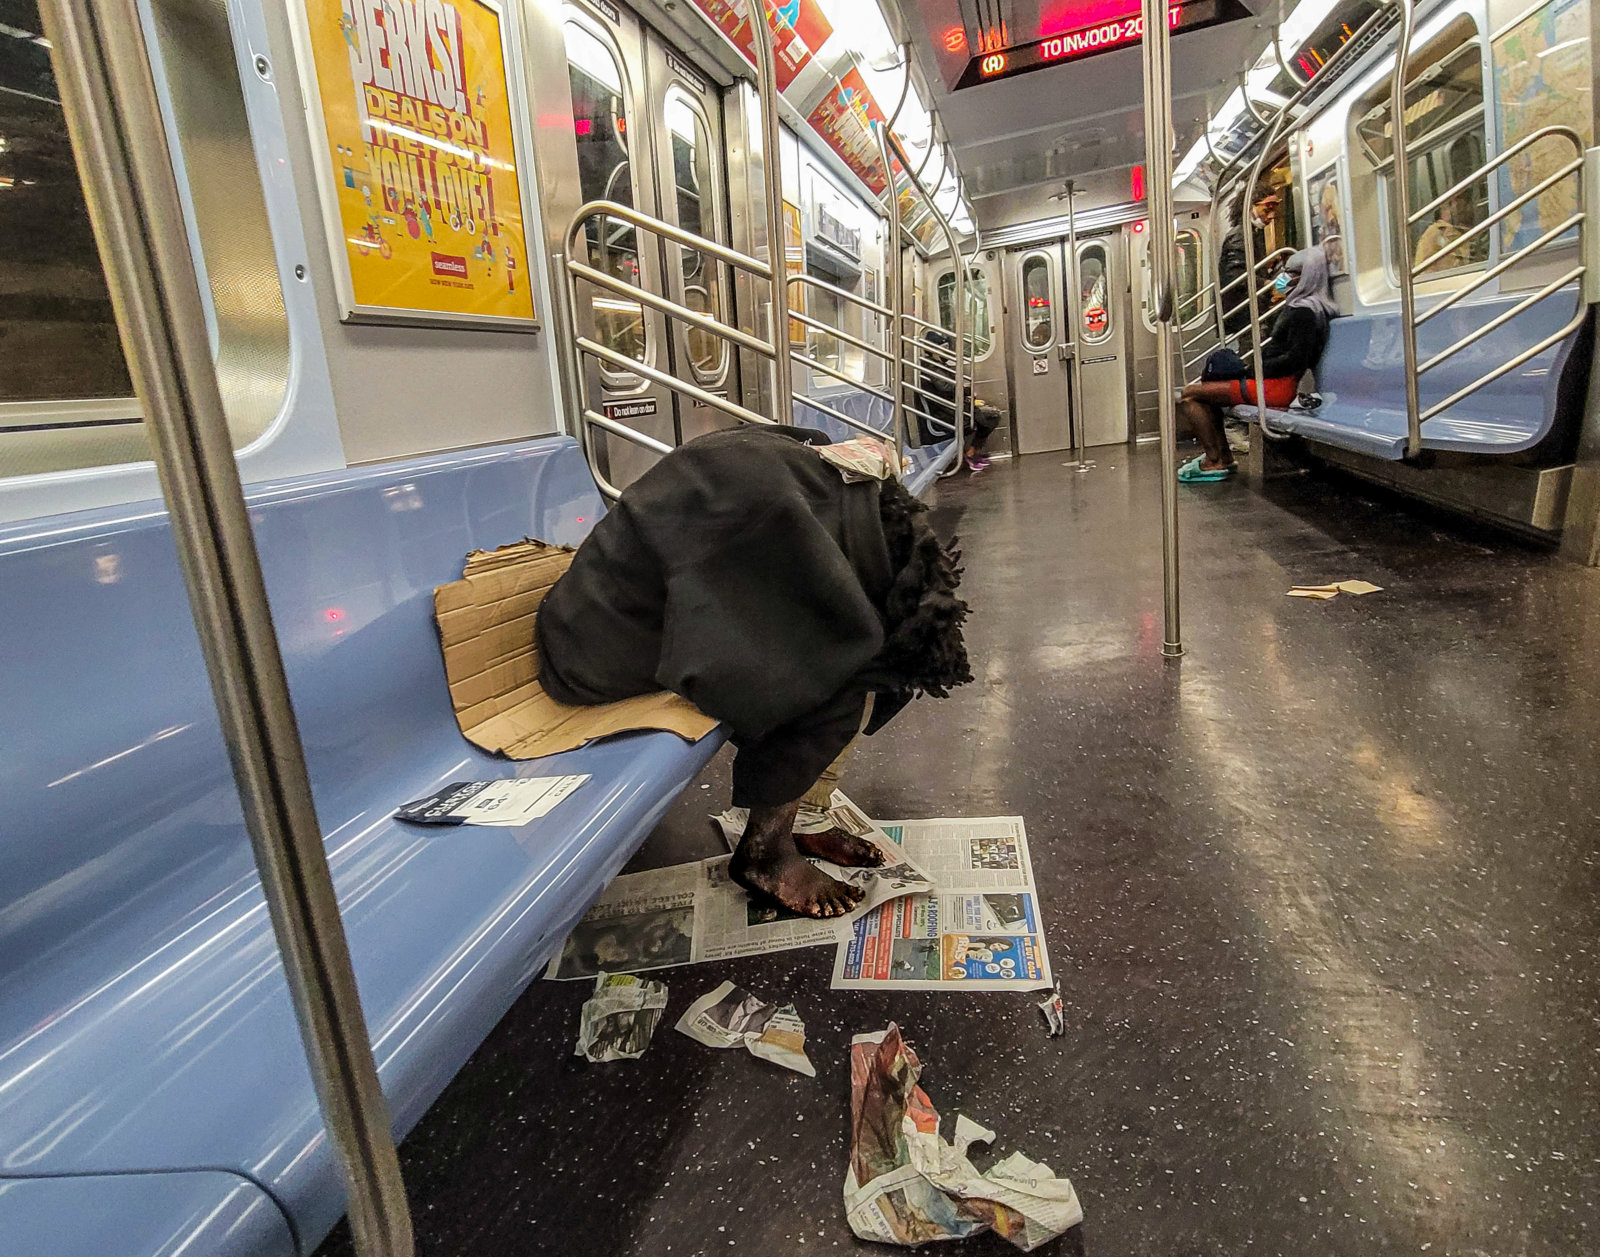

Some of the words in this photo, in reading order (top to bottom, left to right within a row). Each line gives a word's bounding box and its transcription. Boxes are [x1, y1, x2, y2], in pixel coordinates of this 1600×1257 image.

[1041, 40, 1061, 58] TO
[1063, 17, 1144, 53] INWOOD-20
[982, 54, 1004, 73] (A)
[364, 84, 448, 135] DEALS
[449, 112, 485, 146] ON
[613, 406, 621, 417] Do
[622, 405, 630, 416] not
[630, 405, 639, 415] lean
[645, 404, 655, 413] door
[927, 909, 938, 938] ROOFING
[1026, 946, 1034, 960] BUY
[1027, 961, 1037, 979] GOLD
